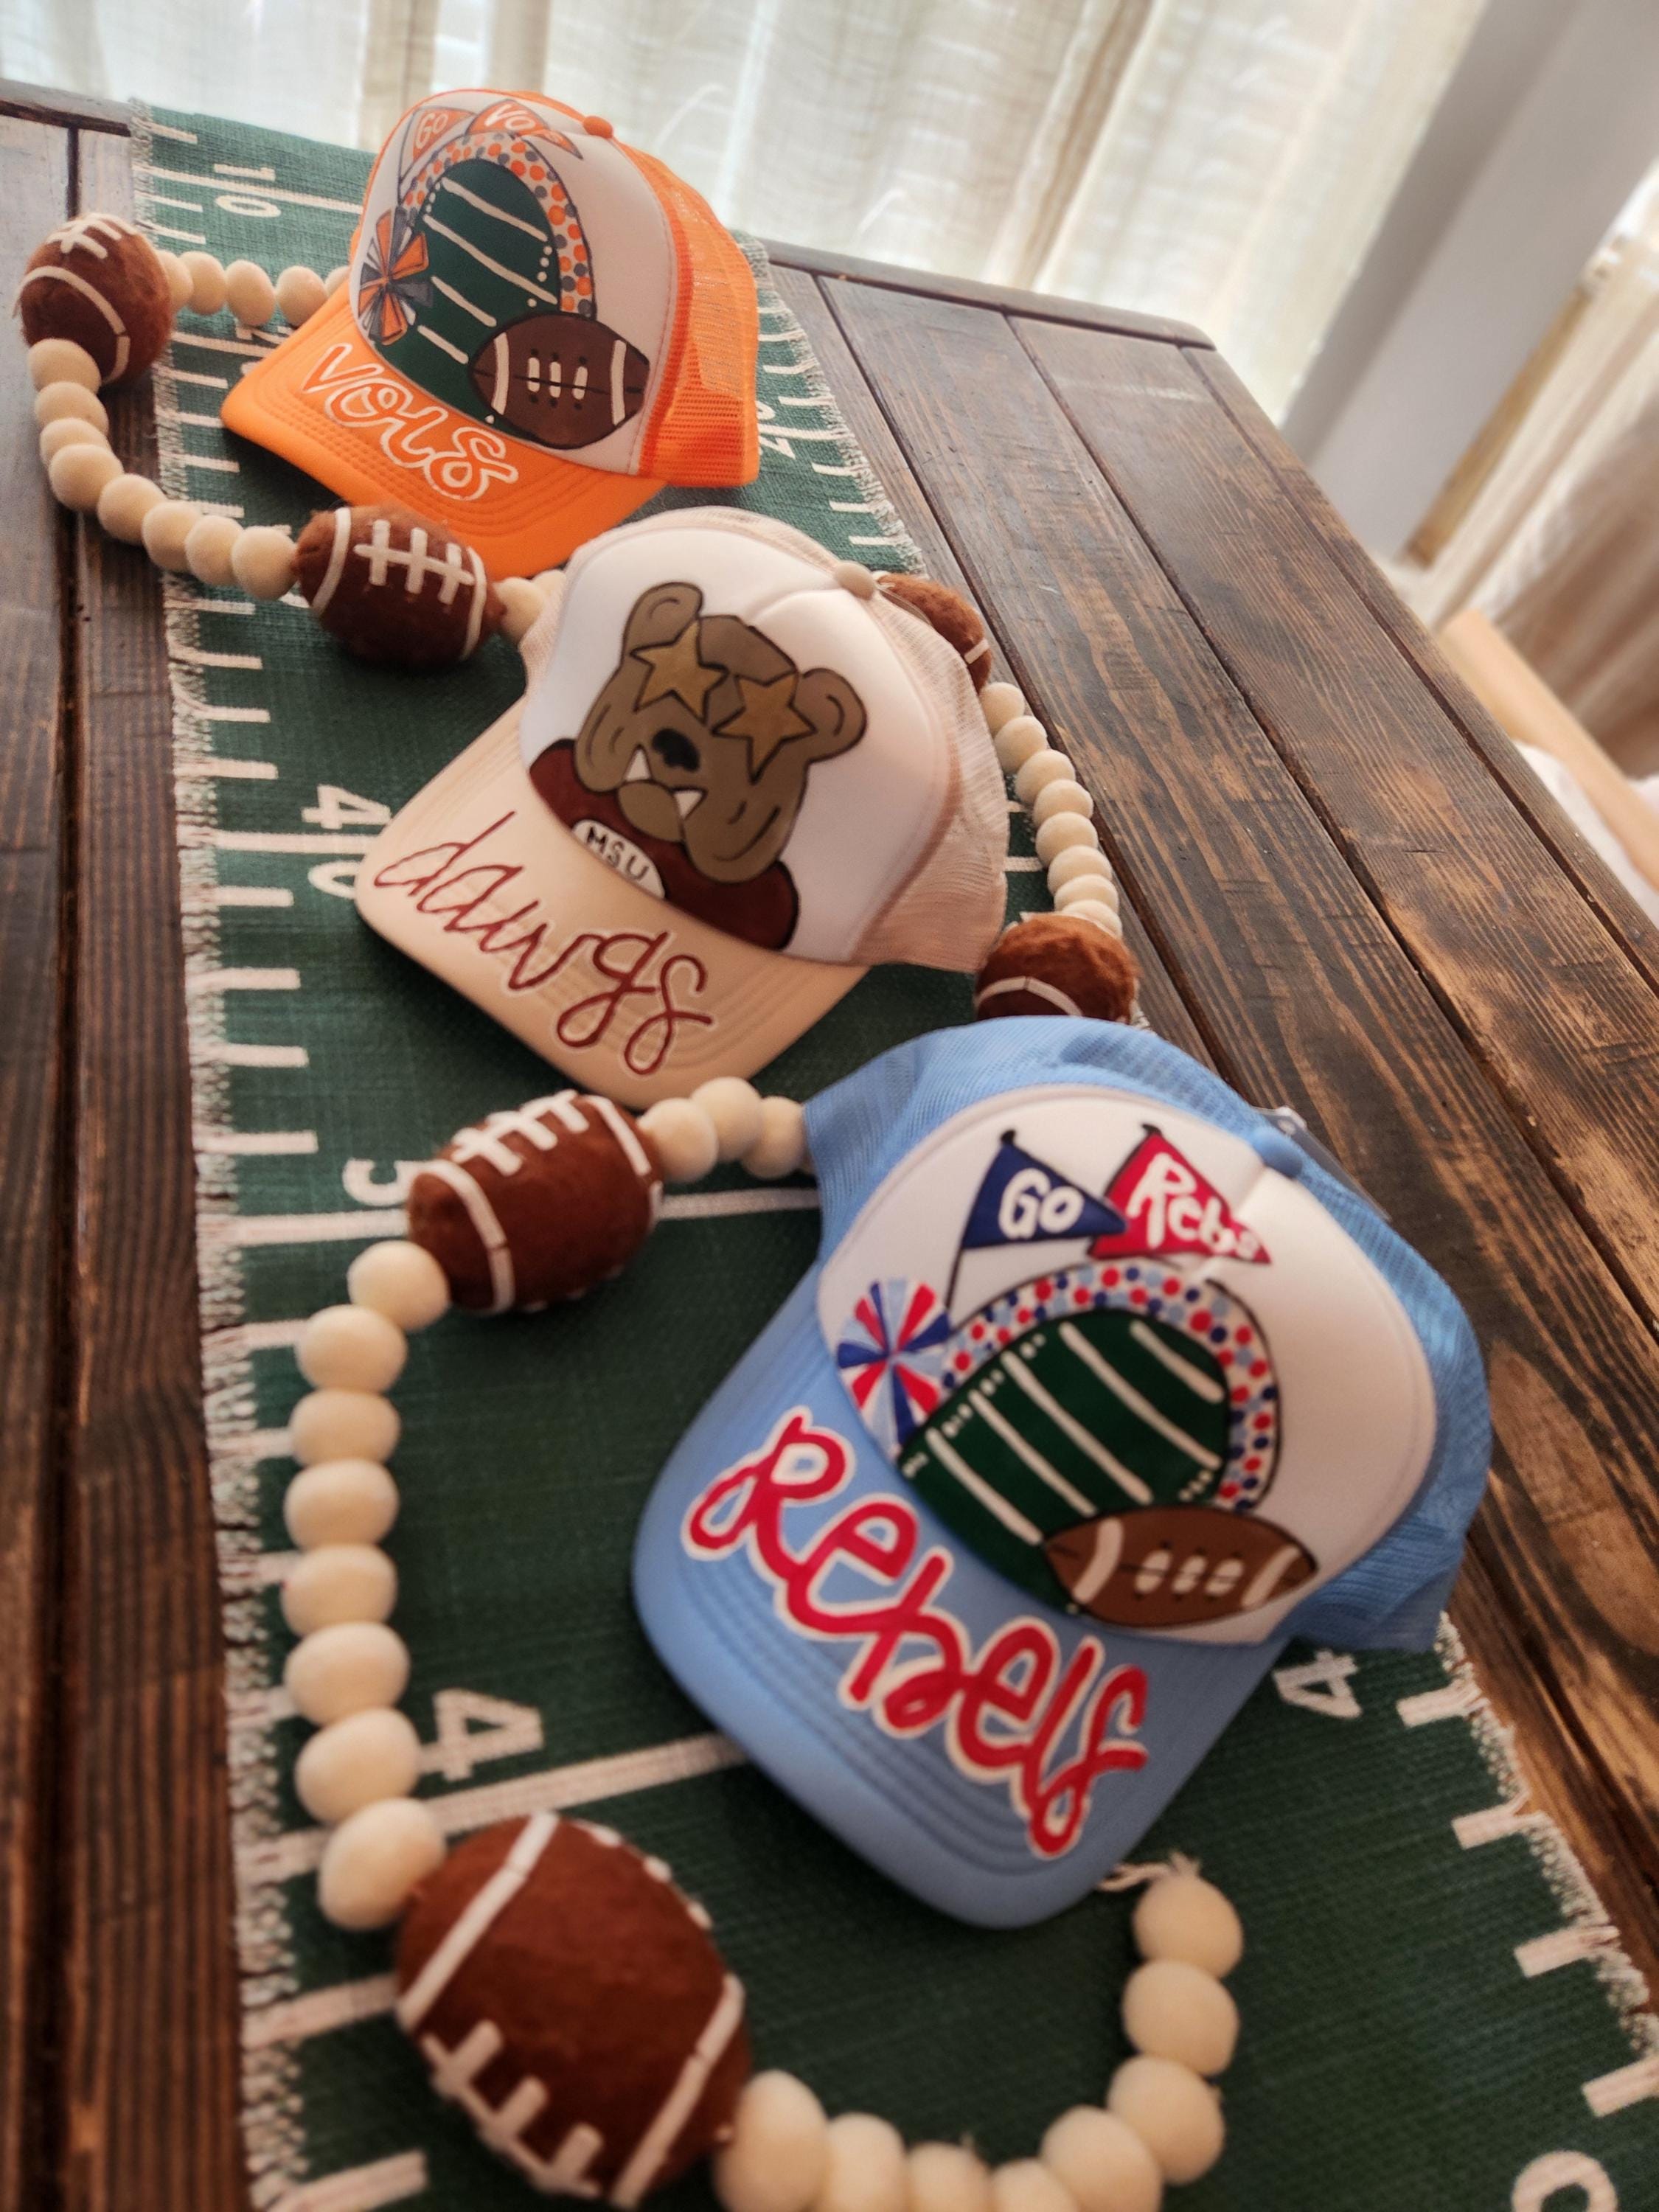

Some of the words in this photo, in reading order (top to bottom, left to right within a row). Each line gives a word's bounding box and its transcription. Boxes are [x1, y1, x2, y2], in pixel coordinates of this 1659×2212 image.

[374, 810, 712, 1075] dawgs
[585, 826, 649, 880] MSU
[680, 1406, 1150, 1860] Rebels
